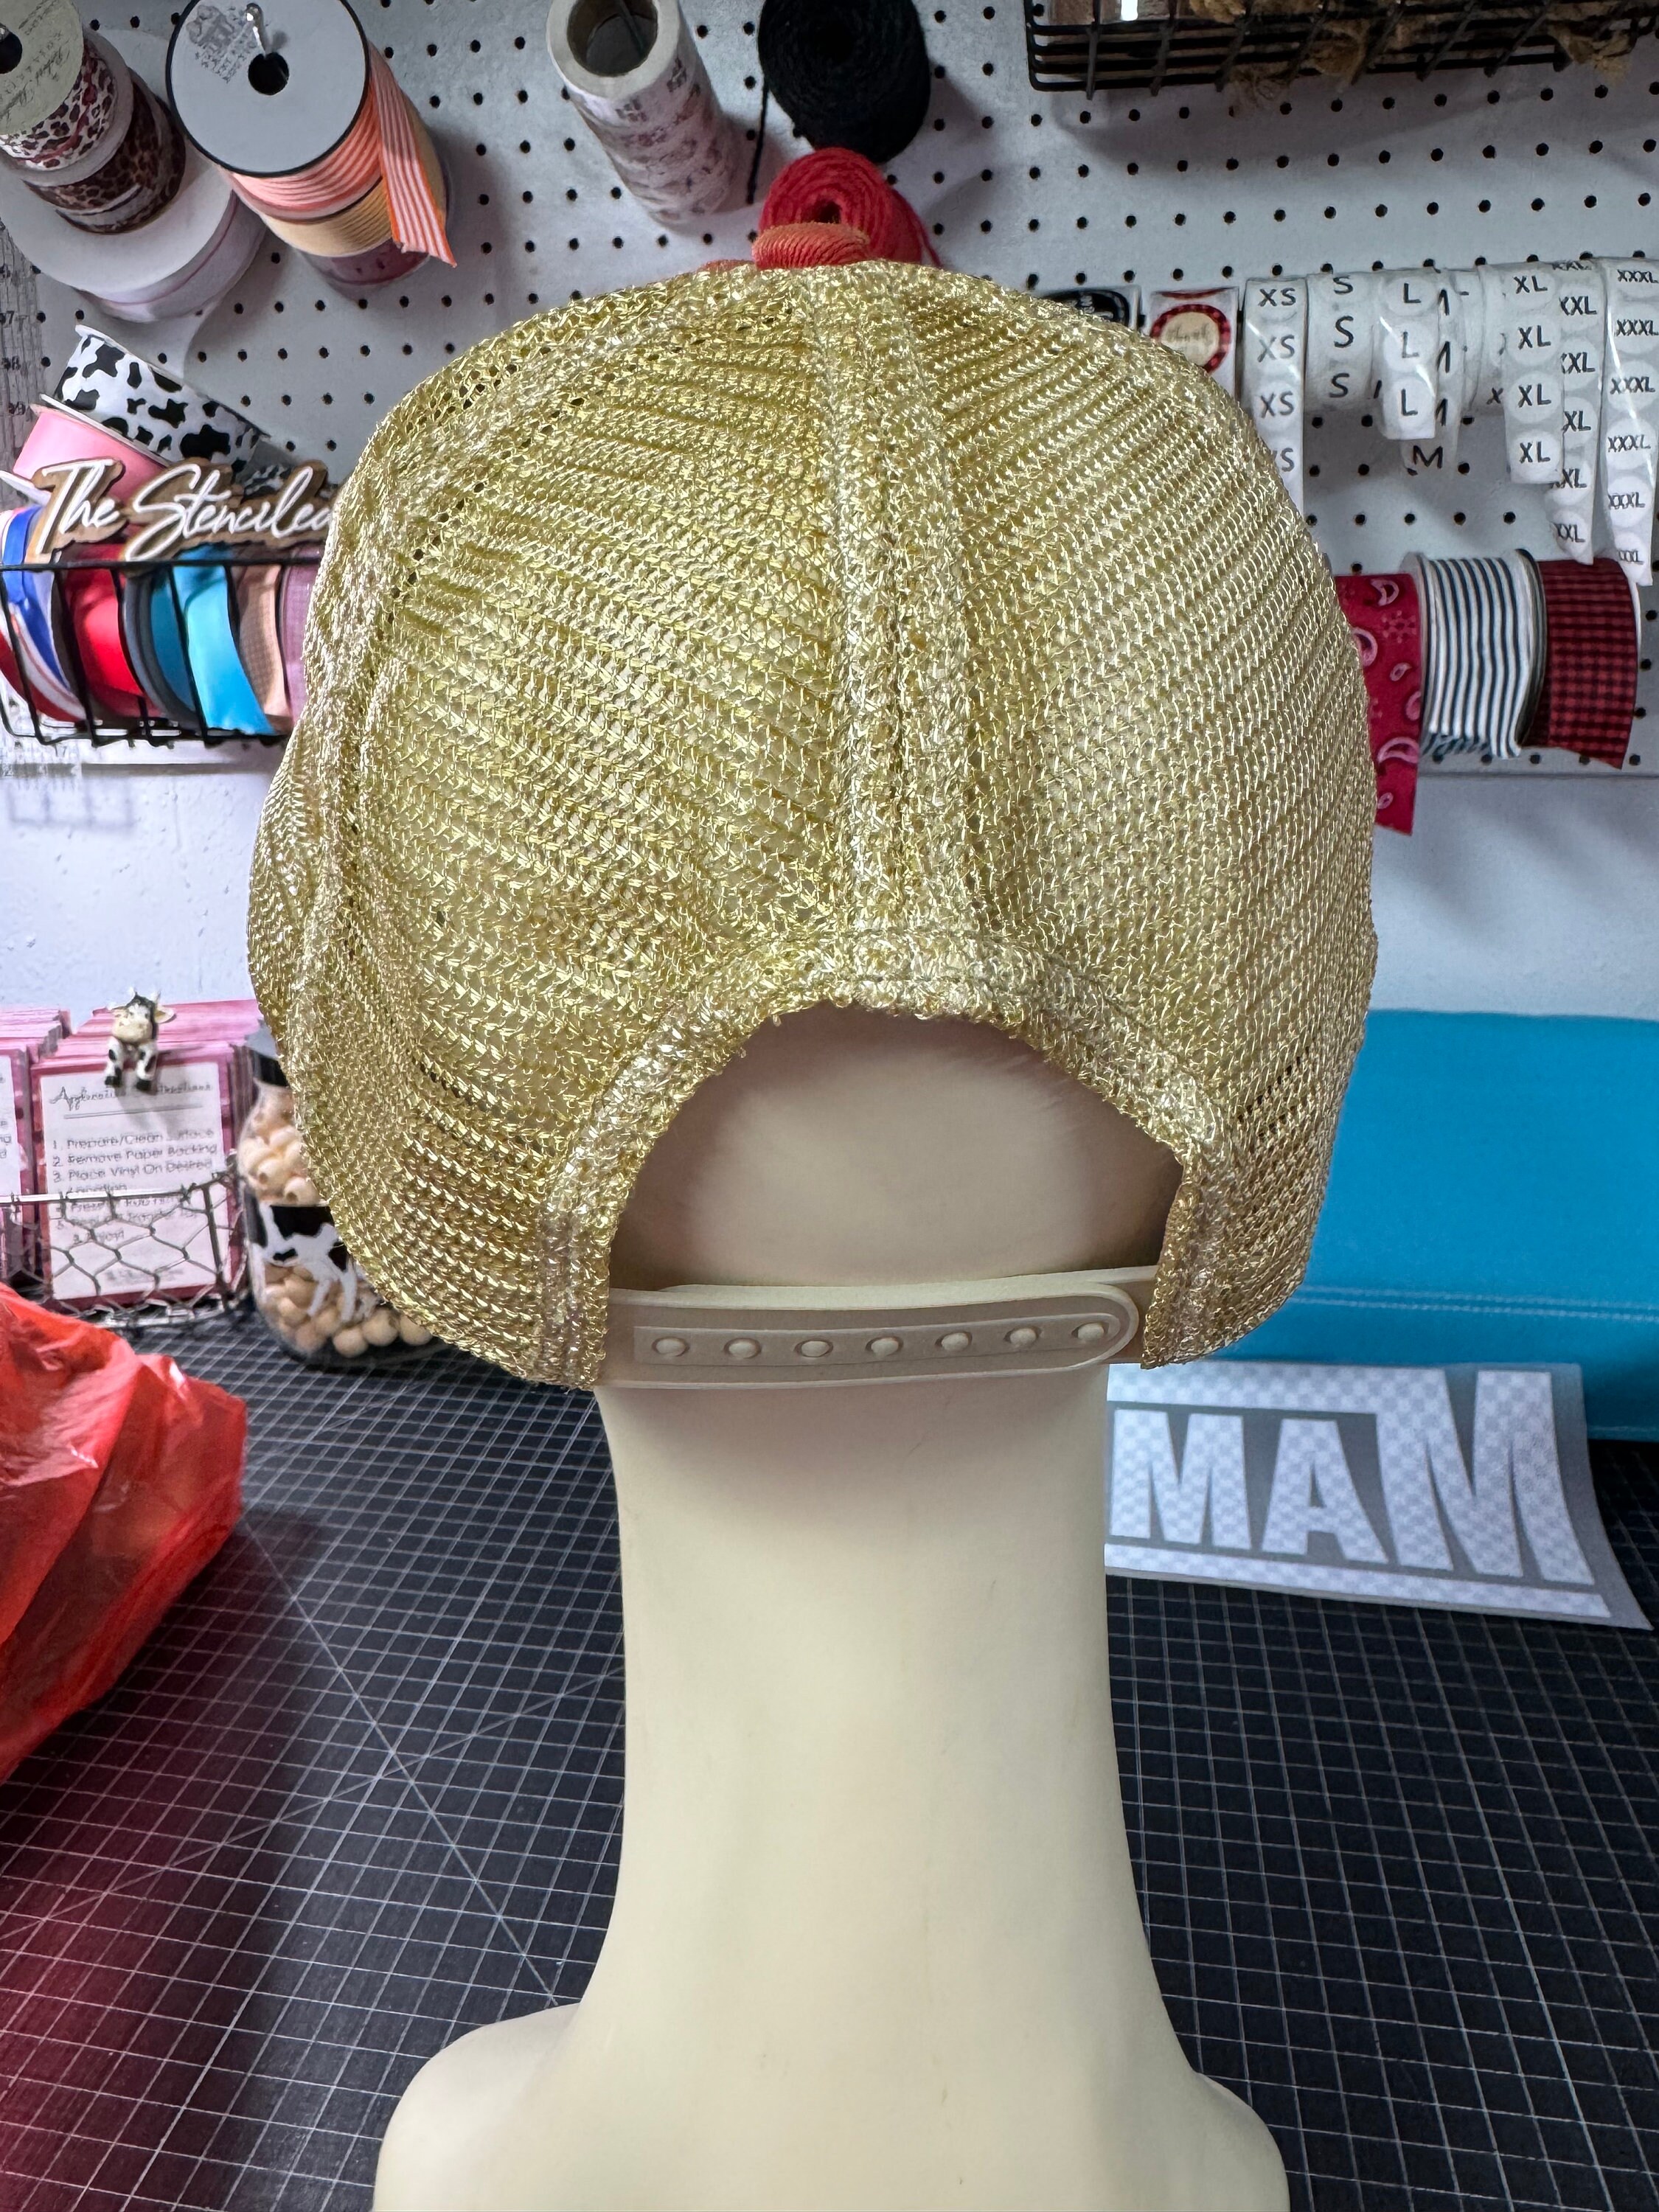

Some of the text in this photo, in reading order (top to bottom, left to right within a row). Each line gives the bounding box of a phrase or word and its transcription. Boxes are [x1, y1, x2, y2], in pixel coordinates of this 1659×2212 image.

[1332, 276, 1354, 295] S
[1404, 282, 1422, 303] L
[1513, 275, 1548, 294] XL
[1257, 288, 1296, 307] XS
[1333, 316, 1354, 348] S
[1402, 331, 1419, 358] L
[1517, 324, 1551, 350] XL
[1257, 334, 1295, 363] XS
[1329, 372, 1349, 398] S
[1517, 383, 1552, 408] XL
[1260, 391, 1295, 419] XS
[1401, 389, 1419, 416] L
[1272, 447, 1295, 472] S
[1413, 445, 1444, 469] M
[1519, 441, 1551, 464] XL
[35, 457, 121, 555] The
